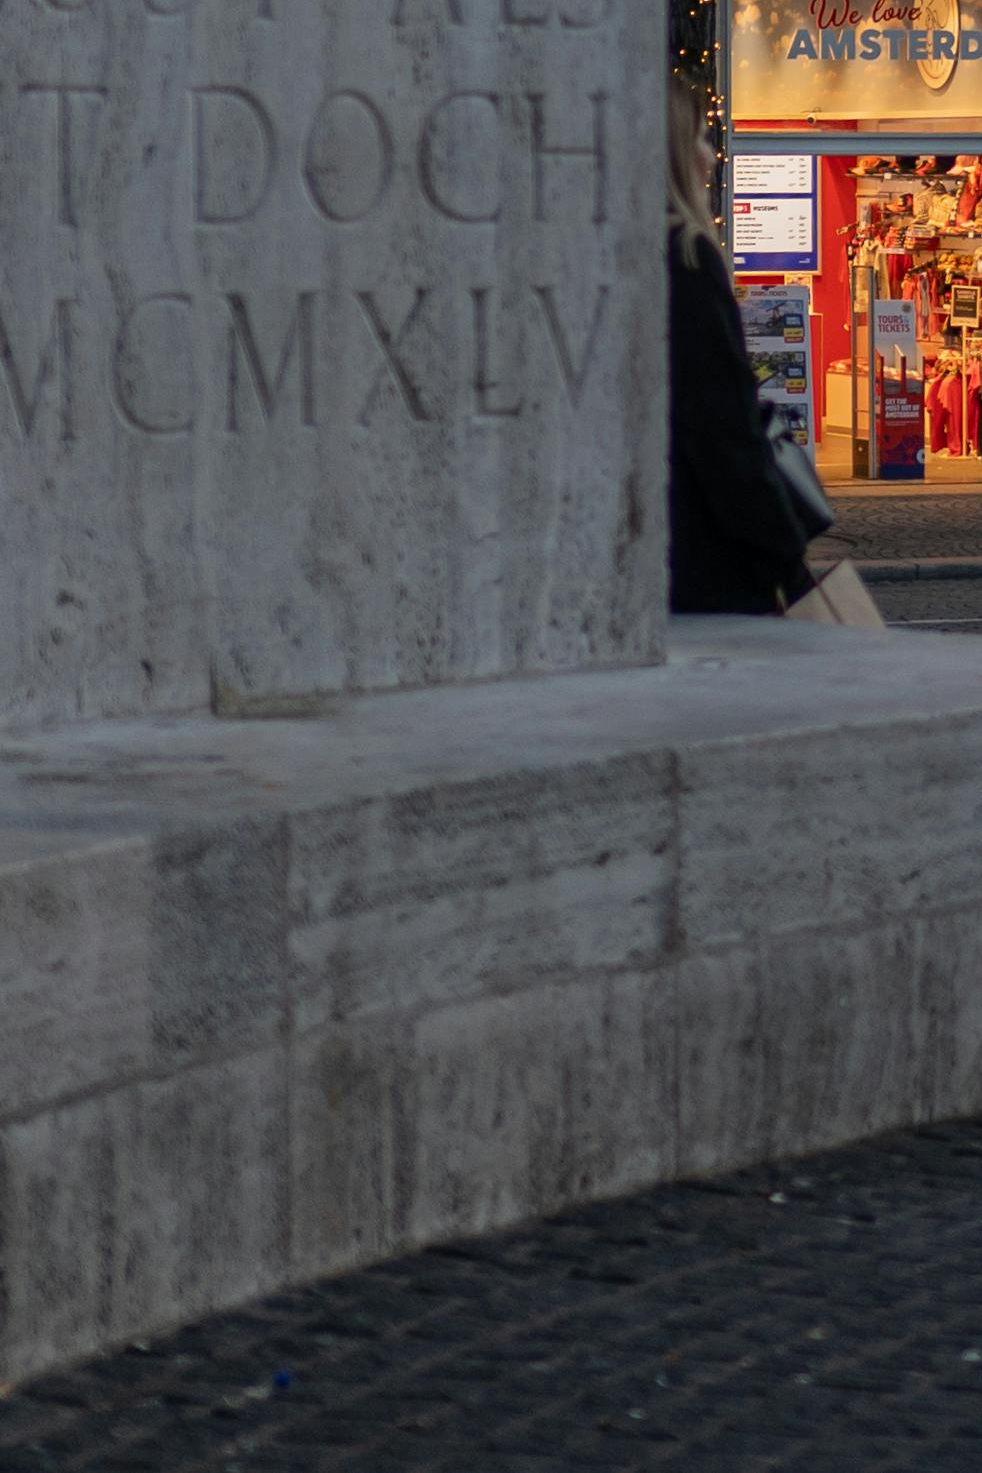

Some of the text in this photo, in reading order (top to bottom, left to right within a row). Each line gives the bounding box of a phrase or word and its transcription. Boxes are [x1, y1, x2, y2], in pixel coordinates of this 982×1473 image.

[190, 83, 608, 225] DOCH
[877, 315, 904, 324] TOURS
[879, 324, 910, 333] TICKETS
